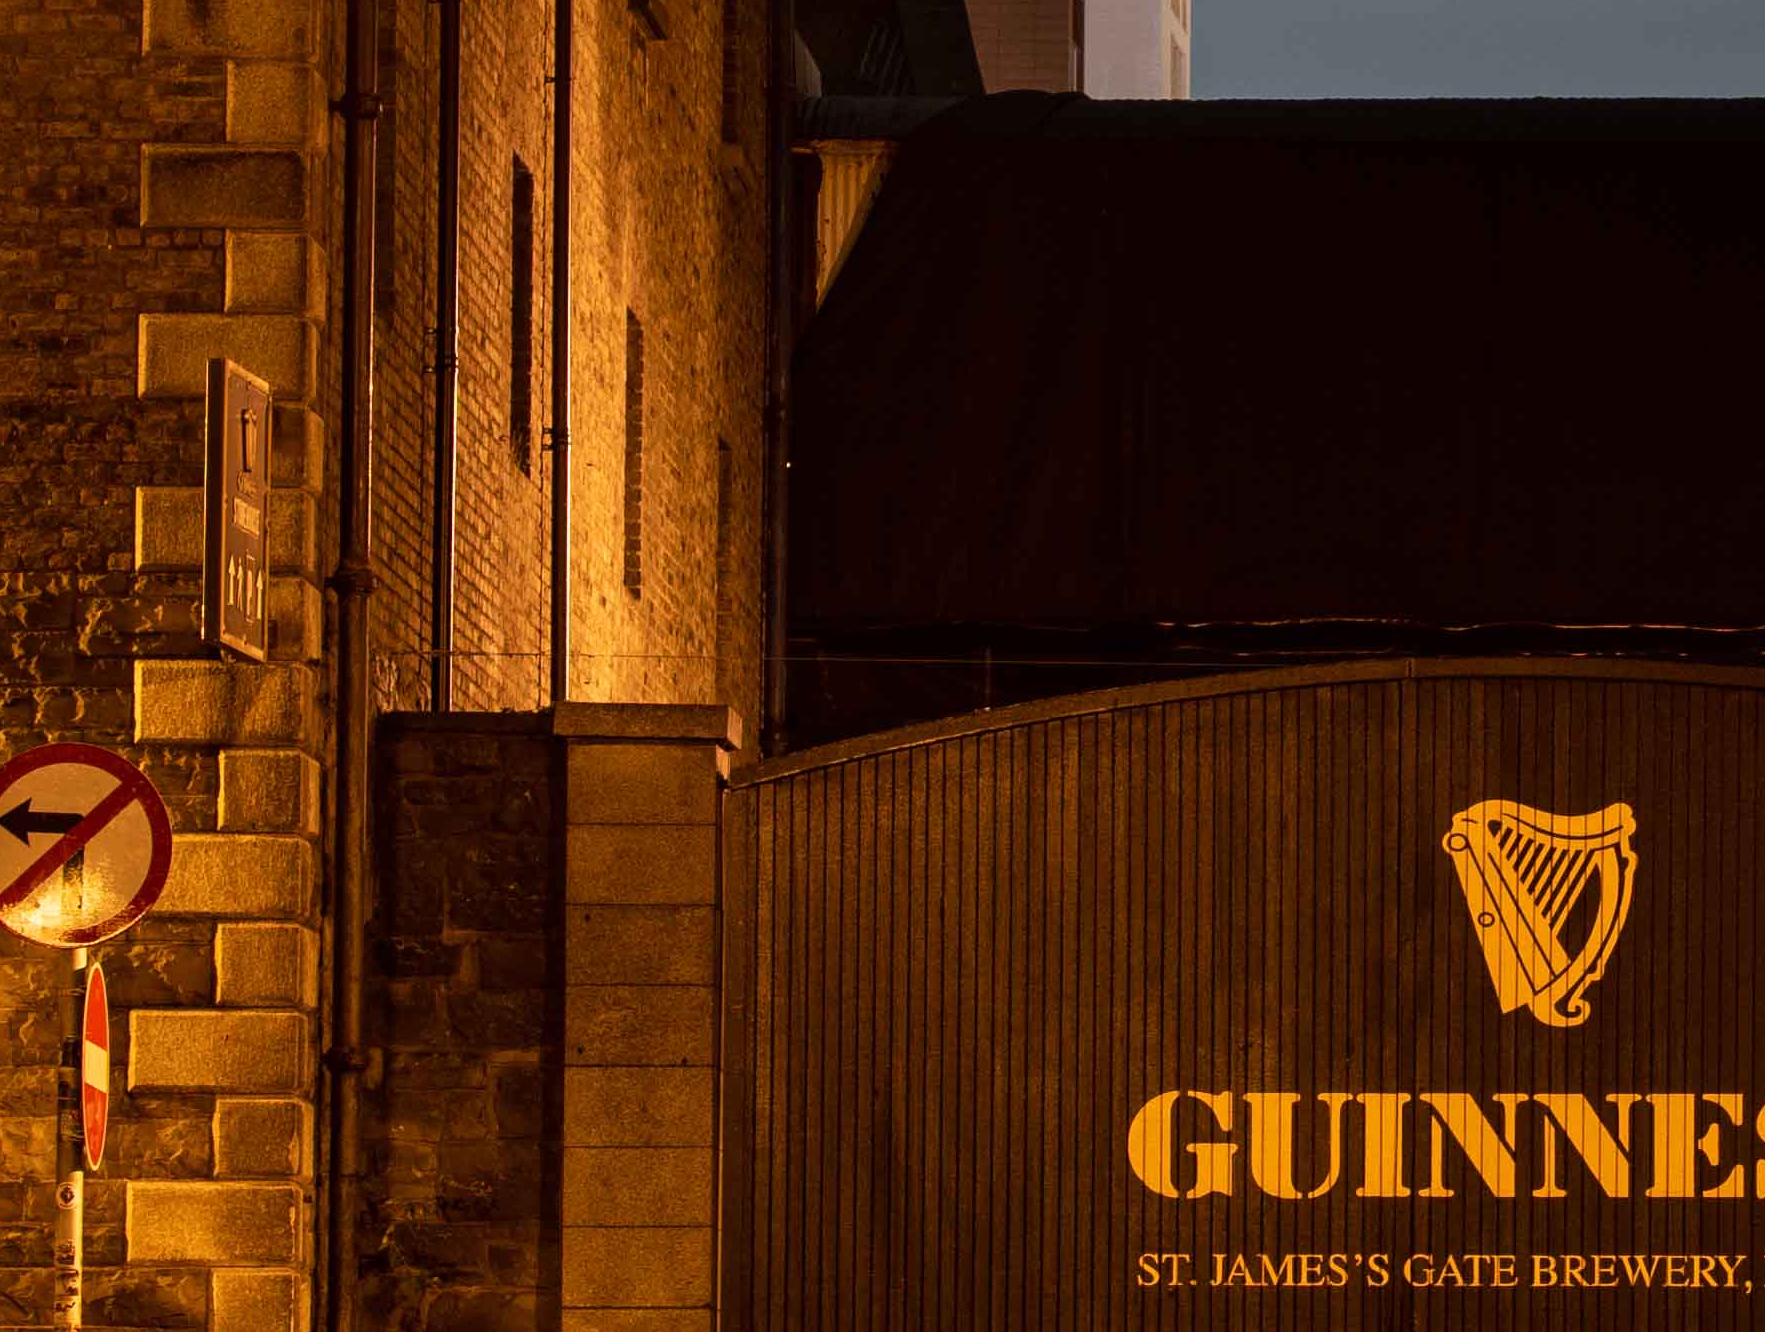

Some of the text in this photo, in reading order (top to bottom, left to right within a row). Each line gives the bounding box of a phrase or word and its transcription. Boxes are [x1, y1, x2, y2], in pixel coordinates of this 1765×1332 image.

[1137, 1253, 1197, 1287] ST.
[1210, 1253, 1389, 1287] JAMES’S
[1403, 1253, 1518, 1288] GATE
[1532, 1254, 1753, 1295] BREWERY,
